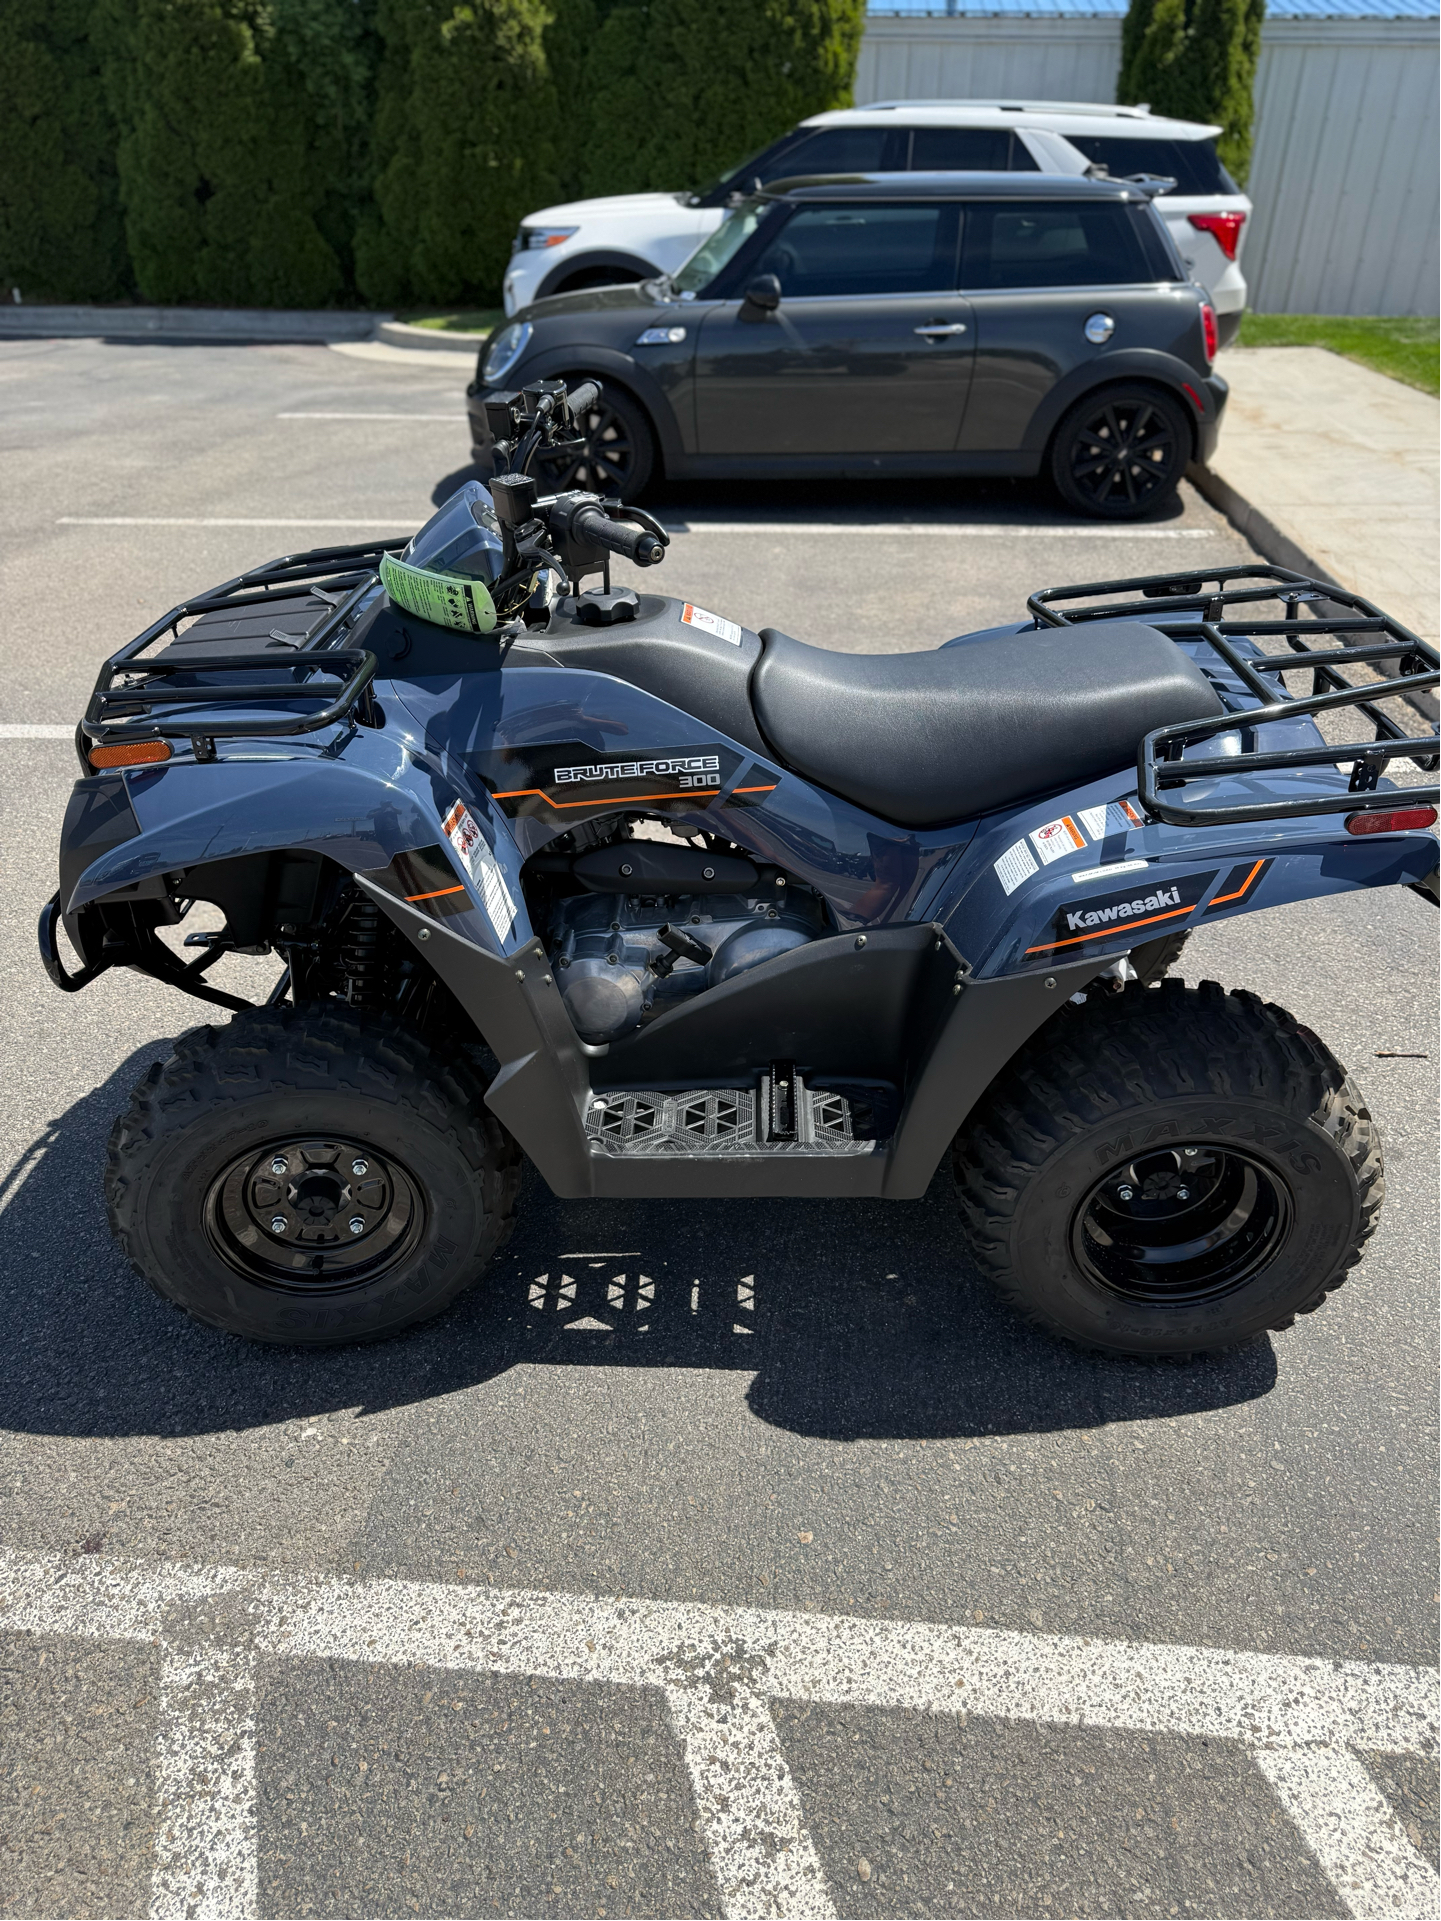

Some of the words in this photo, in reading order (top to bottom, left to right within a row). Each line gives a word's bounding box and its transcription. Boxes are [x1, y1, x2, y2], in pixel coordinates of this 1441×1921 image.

[466, 602, 477, 625] WARNING
[554, 764, 637, 784] BRUTE
[637, 755, 719, 777] FORCE
[679, 773, 720, 788] 300
[1066, 886, 1181, 931] Kawasaki
[1094, 1117, 1322, 1176] MAXXIS
[274, 1233, 459, 1330] MAXXIS
